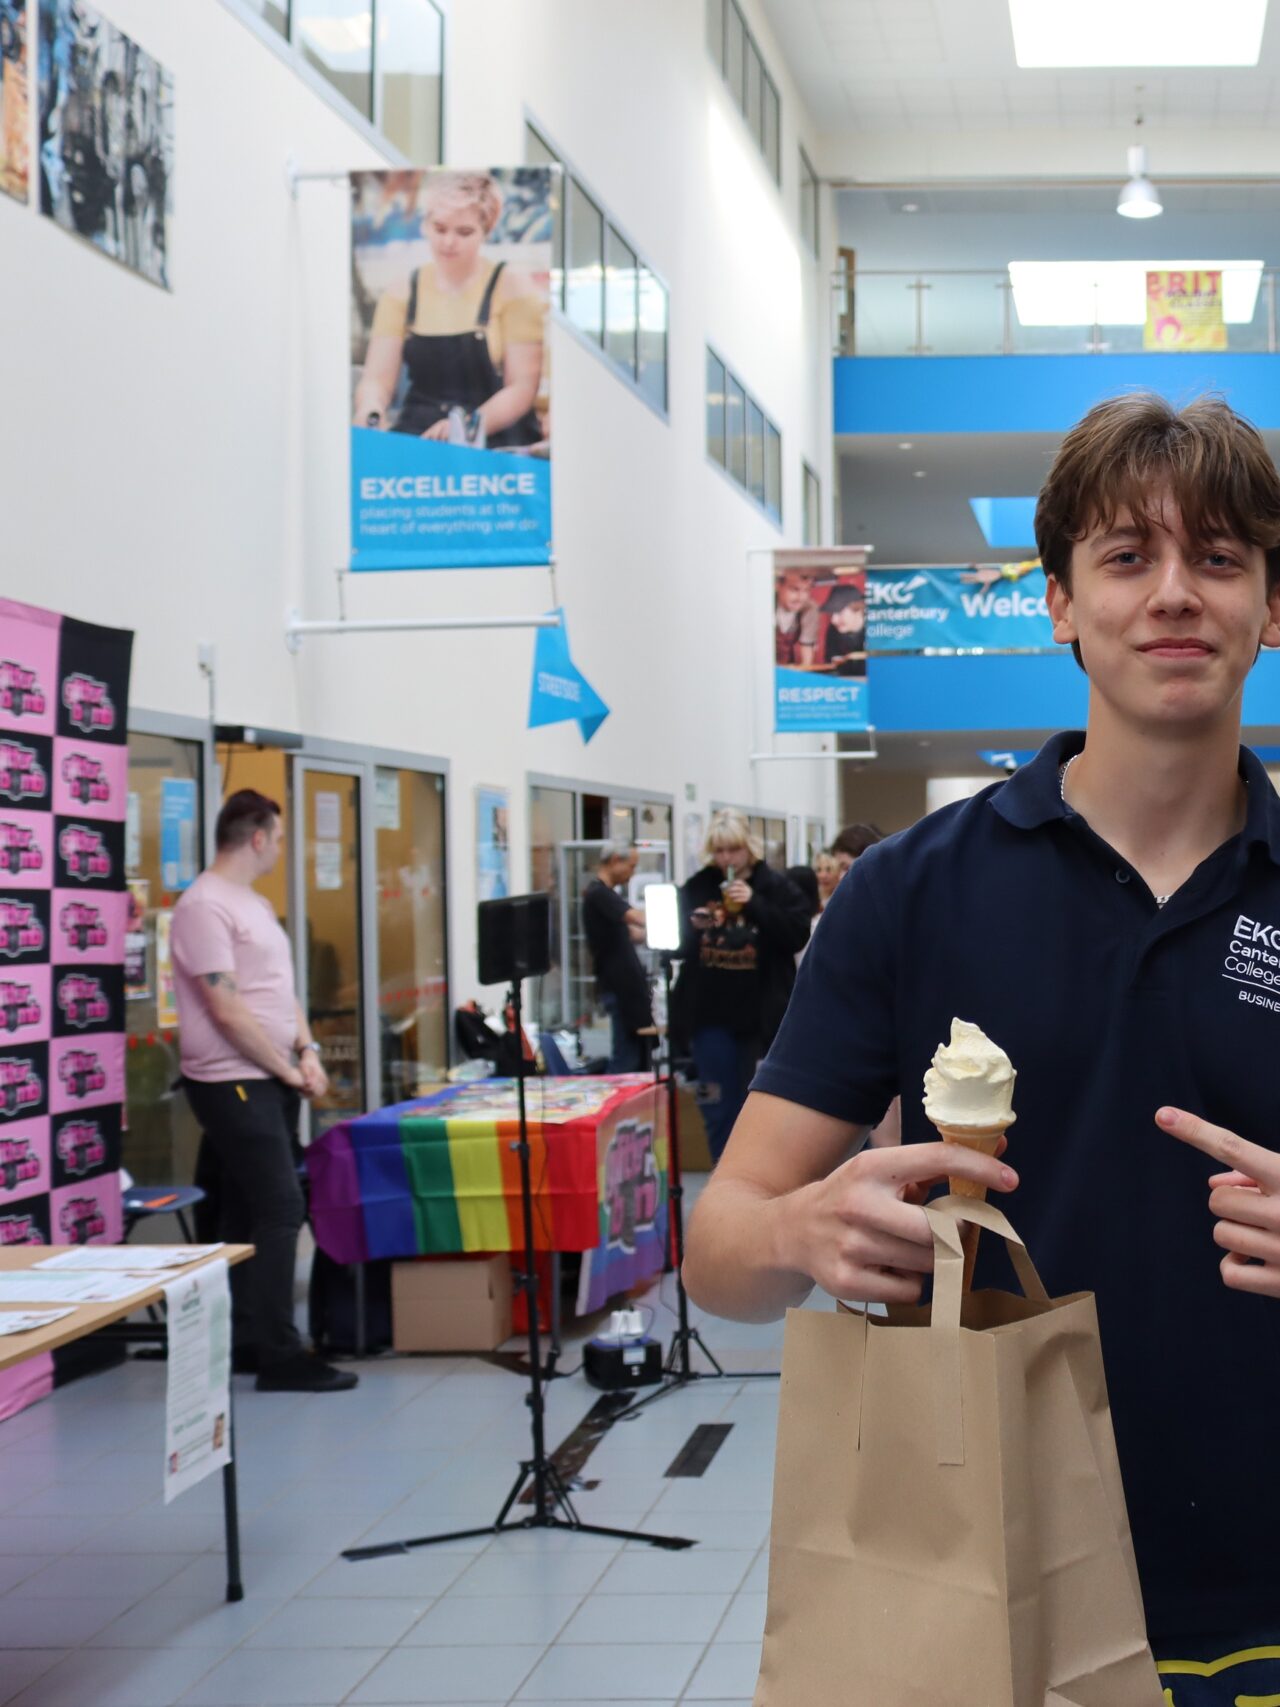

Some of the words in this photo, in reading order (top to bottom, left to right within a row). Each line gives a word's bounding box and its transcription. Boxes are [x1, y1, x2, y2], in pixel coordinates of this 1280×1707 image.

[361, 473, 536, 500] EXCELLENCE
[360, 506, 412, 520] placing
[416, 504, 476, 517] students
[479, 504, 494, 516] at
[496, 502, 521, 515] the
[360, 522, 397, 535] heart
[399, 521, 416, 533] of
[418, 520, 493, 535] everything
[496, 519, 516, 531] we
[866, 605, 950, 623] anterbury
[866, 624, 914, 641] ollege
[778, 687, 860, 703] RESPECT
